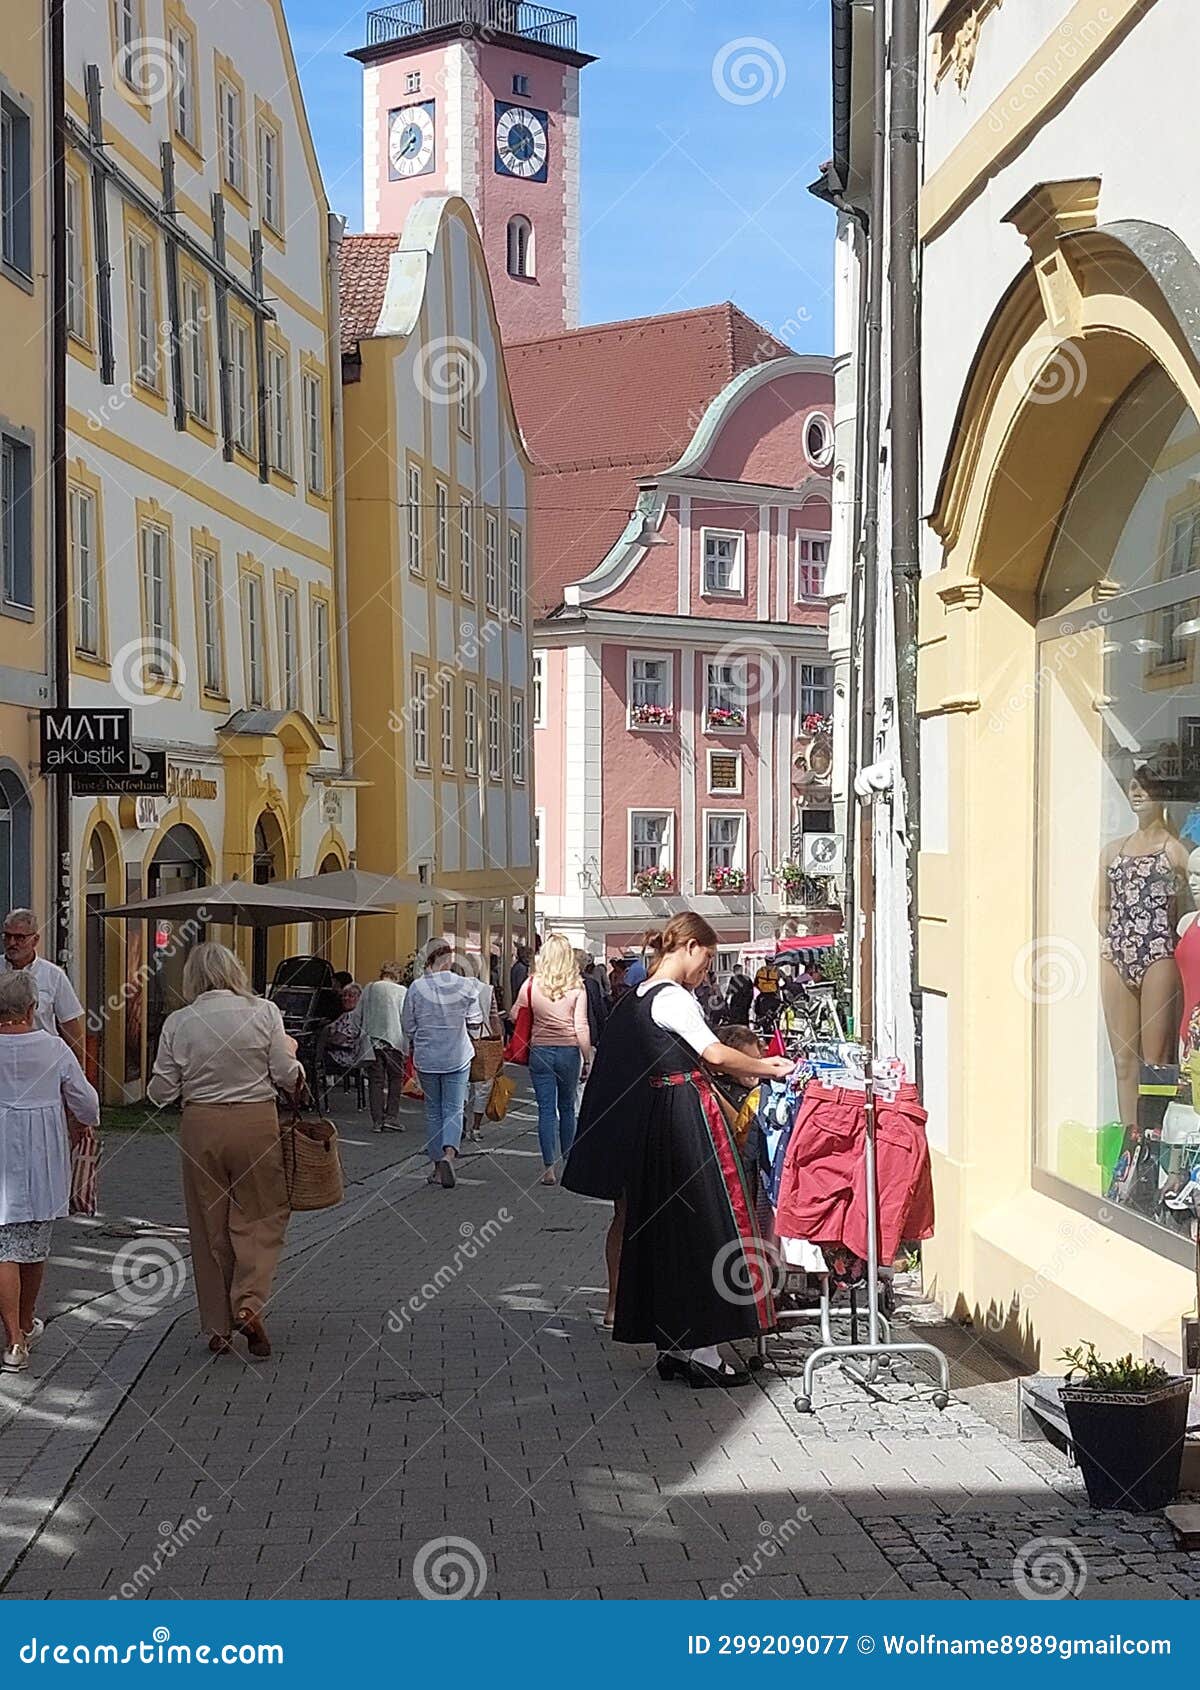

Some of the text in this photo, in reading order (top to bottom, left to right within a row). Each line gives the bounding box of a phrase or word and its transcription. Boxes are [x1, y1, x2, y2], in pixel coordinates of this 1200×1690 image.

[46, 715, 125, 740] MATT
[47, 746, 125, 764] akustik
[106, 780, 165, 791] Kaffeehaus
